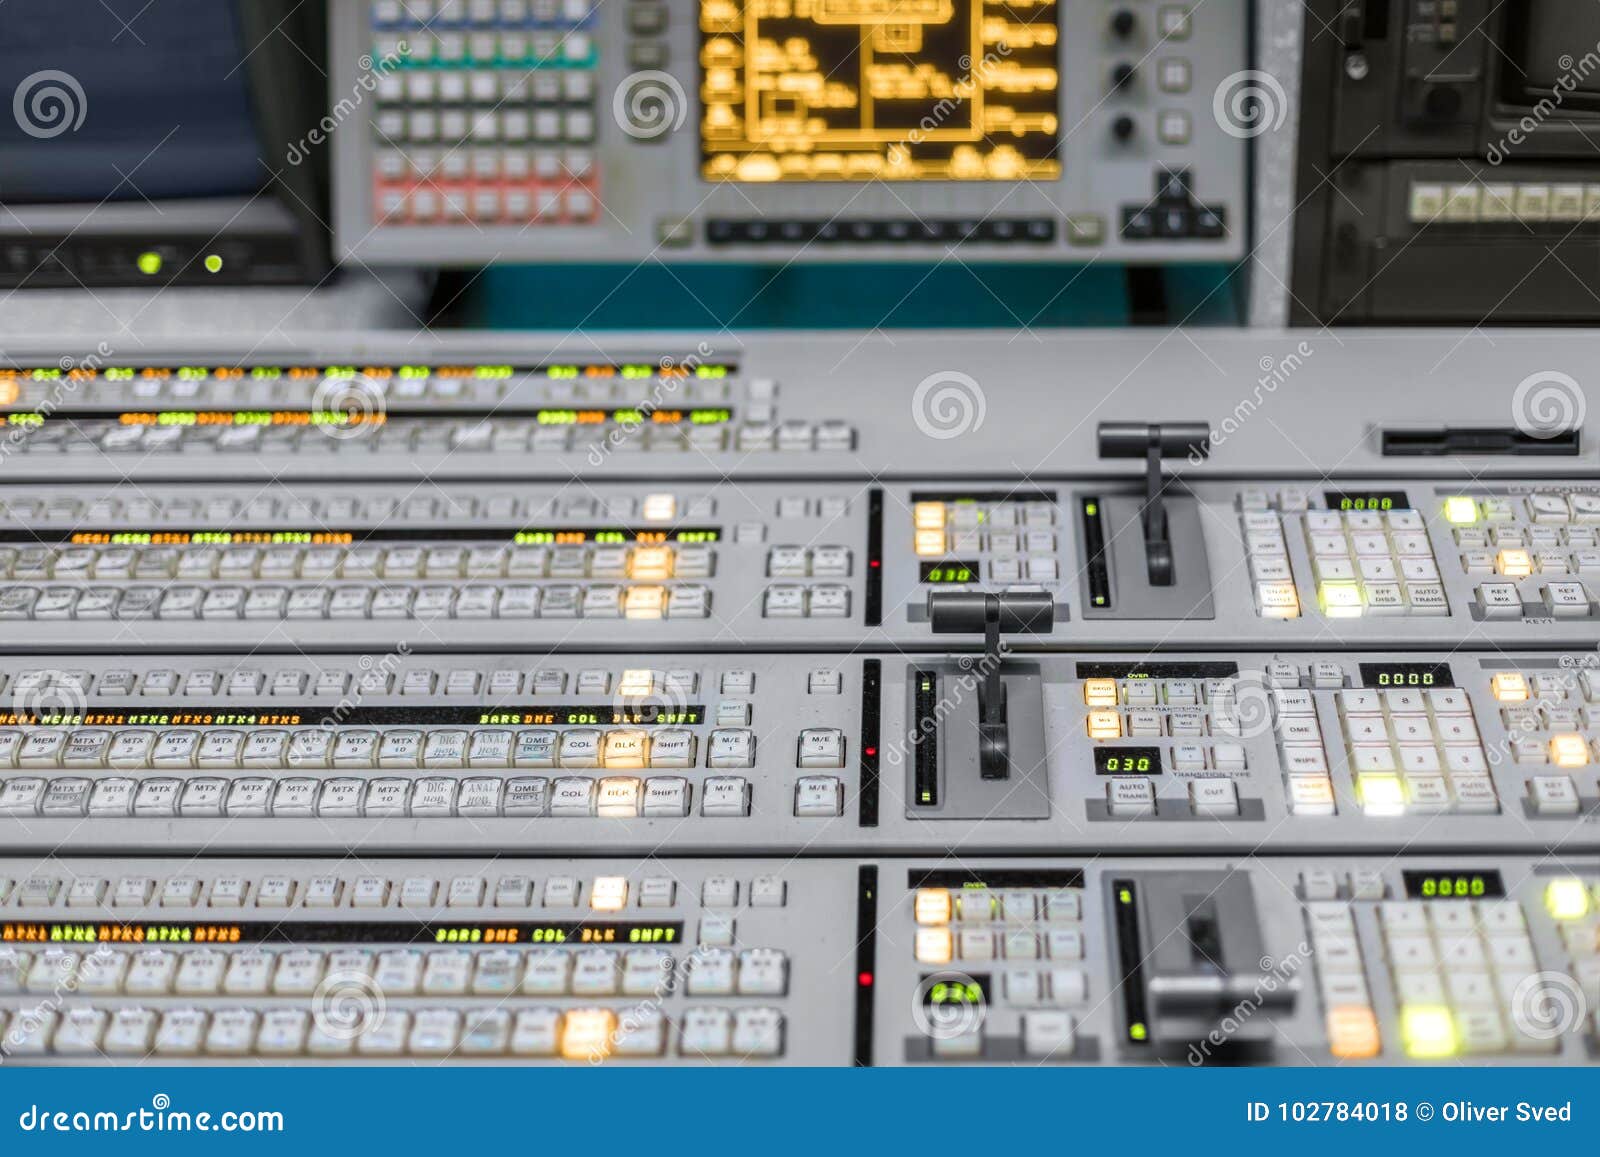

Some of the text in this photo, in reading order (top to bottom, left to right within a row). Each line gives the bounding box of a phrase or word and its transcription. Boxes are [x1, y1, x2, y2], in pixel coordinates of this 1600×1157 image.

[1379, 673, 1433, 685] 0000
[84, 714, 125, 725] MTX1
[128, 714, 169, 725] MTX2
[171, 714, 212, 725] MTX3
[215, 714, 256, 724] MTX4
[259, 714, 300, 725] MTX5
[479, 714, 520, 724] BARS
[523, 714, 554, 724] DME
[568, 714, 598, 724] COL
[657, 713, 697, 723] SHFT
[1107, 758, 1149, 771] 030
[11, 784, 35, 792] MEM
[532, 928, 566, 943] COL
